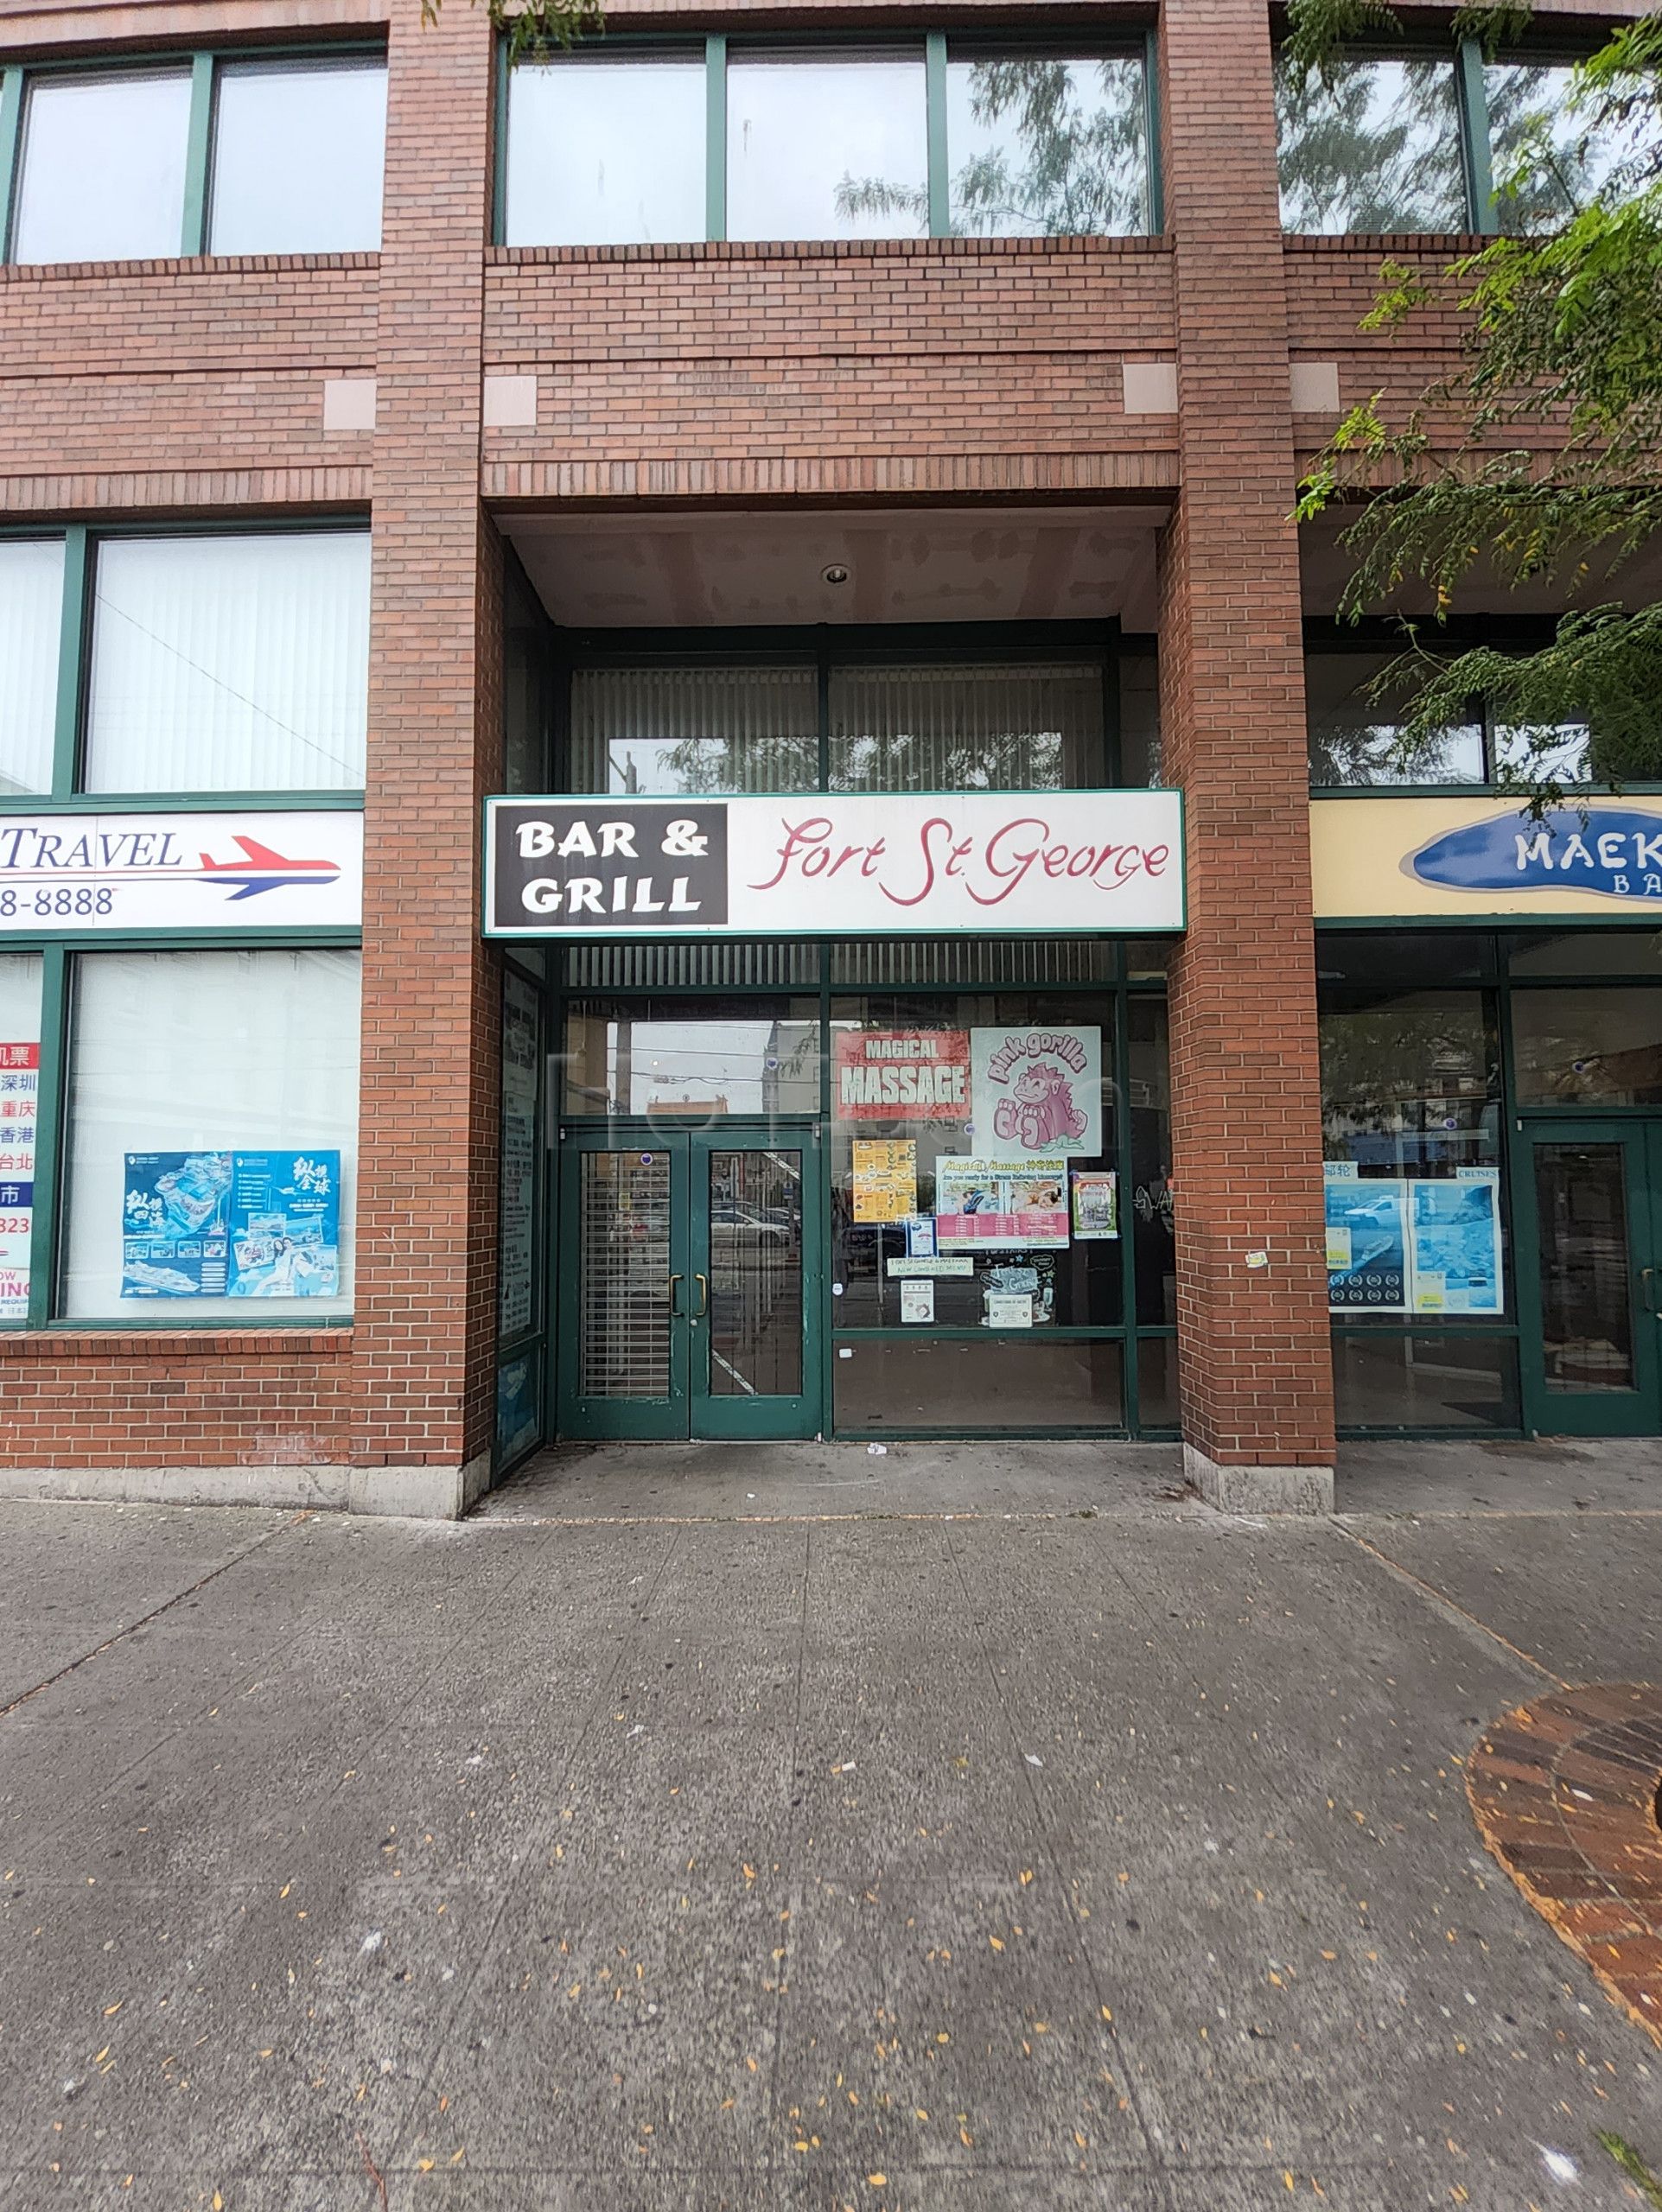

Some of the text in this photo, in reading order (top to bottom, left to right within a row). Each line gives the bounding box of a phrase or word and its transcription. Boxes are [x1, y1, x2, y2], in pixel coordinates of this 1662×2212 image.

[515, 820, 710, 858] BAR &
[746, 817, 886, 890] Fort
[965, 818, 1169, 906] George
[0, 887, 113, 917] 8-8888
[521, 875, 702, 914] GRILL
[865, 1039, 940, 1059] MAGICAL
[988, 1033, 1089, 1084] pink gorilla
[0, 1074, 36, 1092] 深圳
[840, 1065, 966, 1105] MASSAGE
[0, 1100, 36, 1117] 重庆
[0, 1126, 35, 1144] 香港
[0, 1153, 33, 1171] 台北
[0, 1185, 21, 1205] 市
